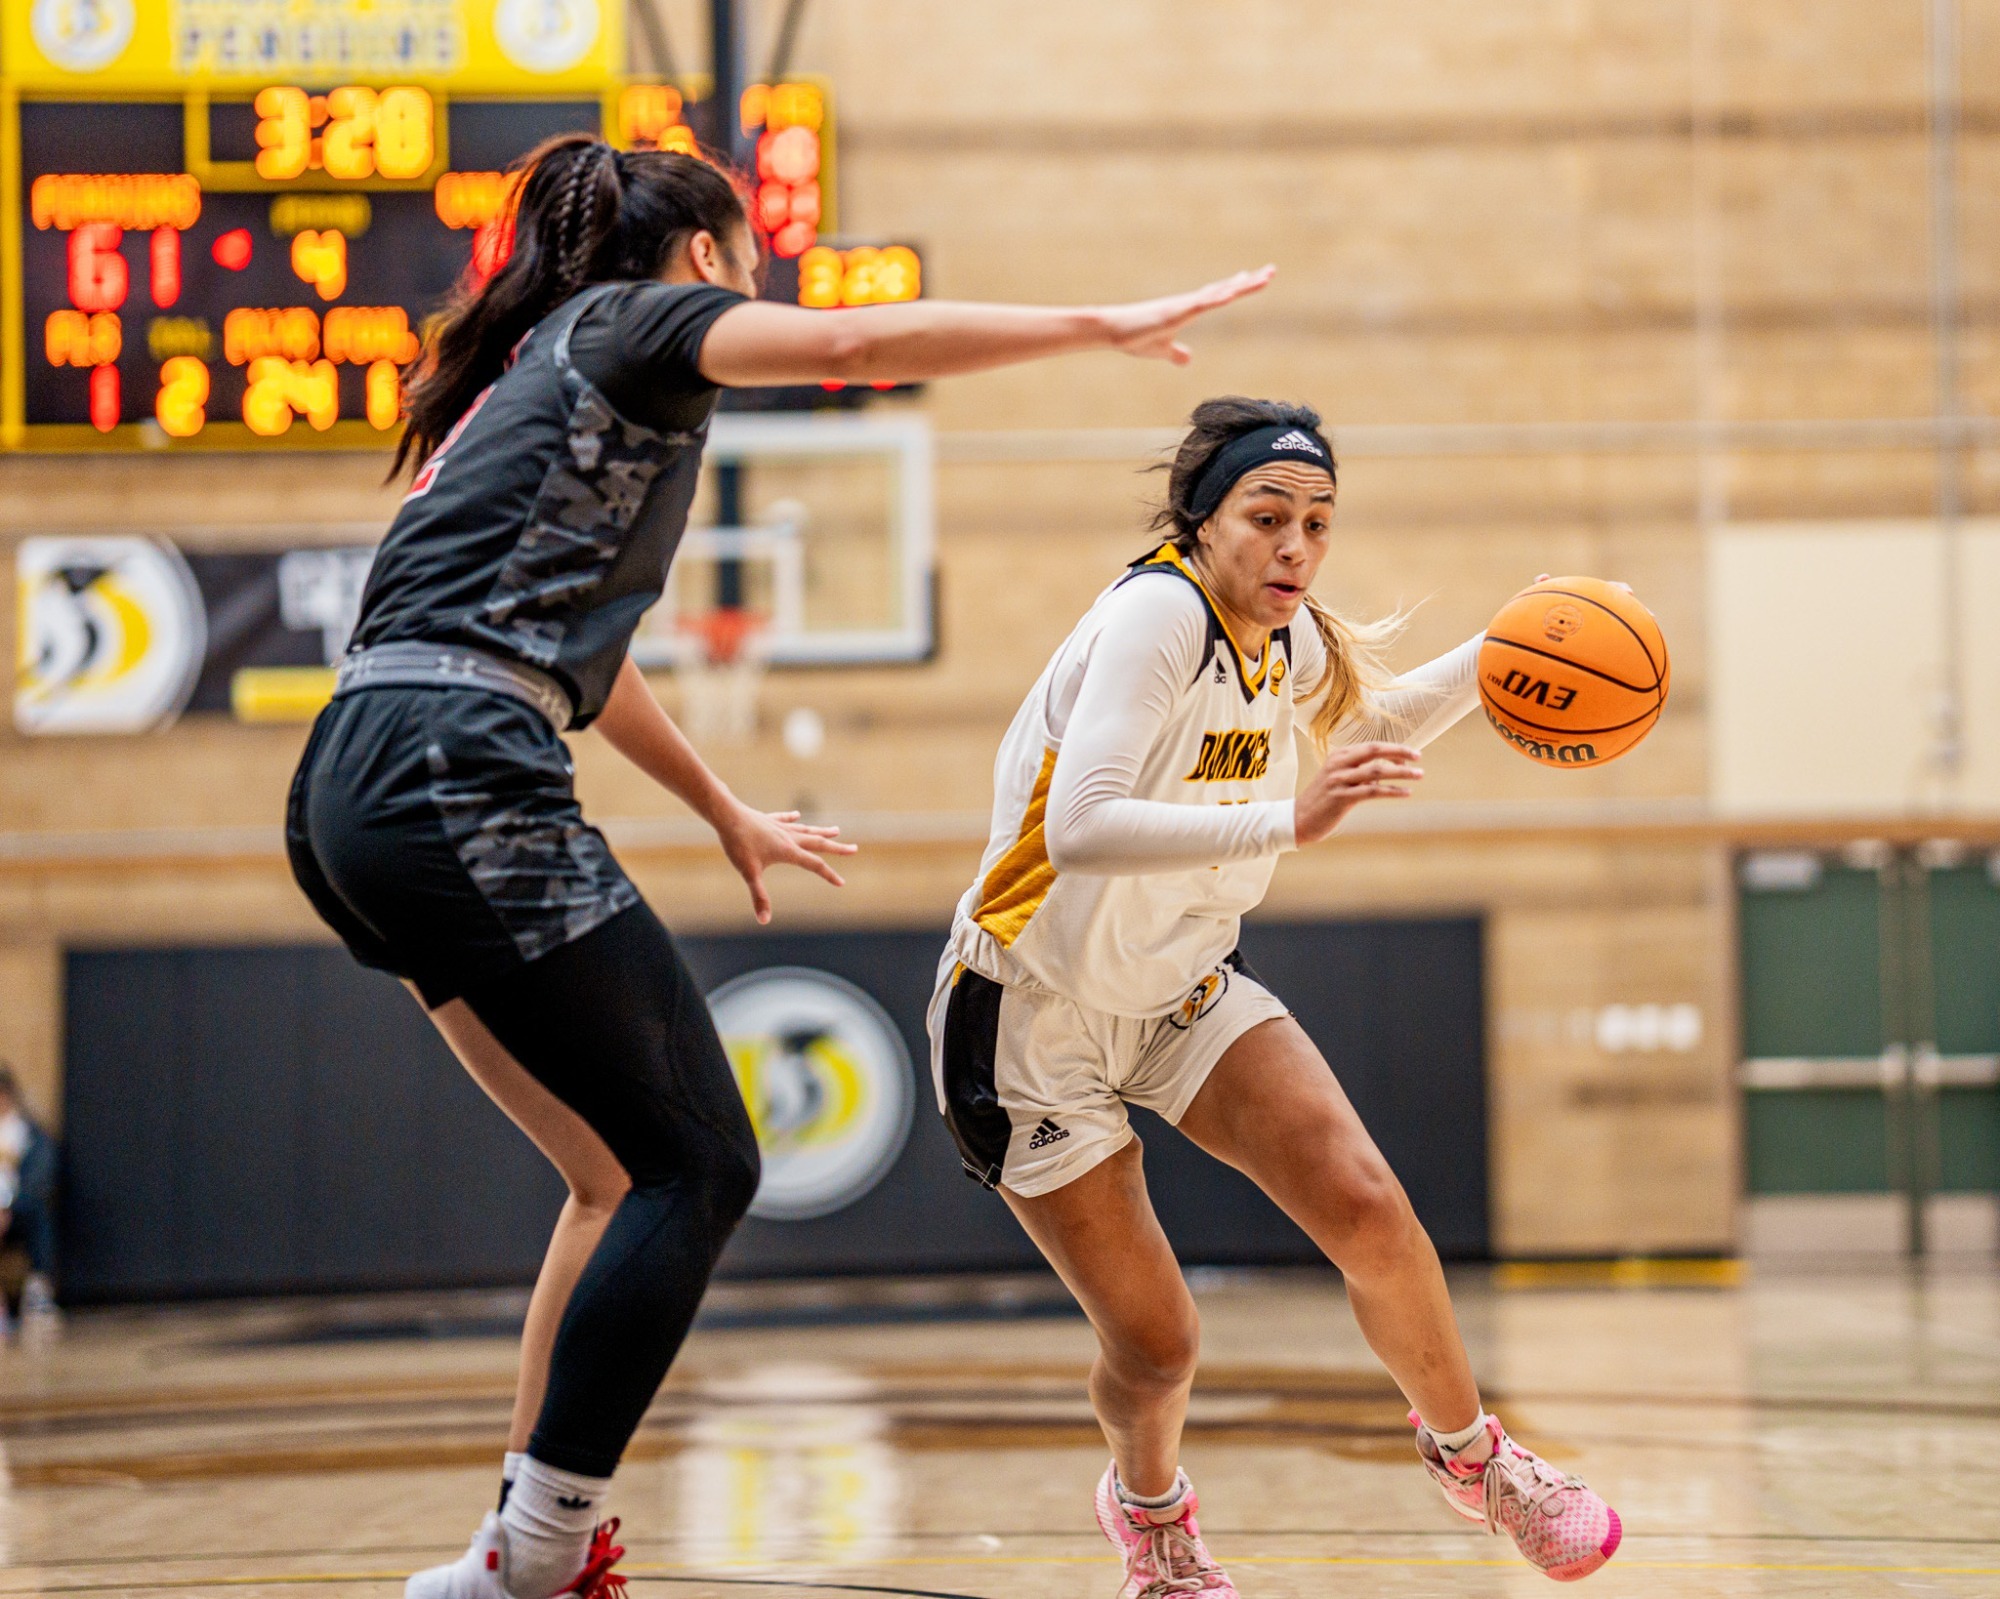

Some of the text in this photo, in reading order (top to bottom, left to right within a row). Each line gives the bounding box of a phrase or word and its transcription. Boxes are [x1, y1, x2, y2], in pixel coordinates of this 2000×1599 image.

[156, 356, 209, 436] 2
[1271, 441, 1323, 457] adidas
[1501, 669, 1577, 711] EVO
[1485, 704, 1600, 763] Wilson
[1029, 1129, 1070, 1150] adidas
